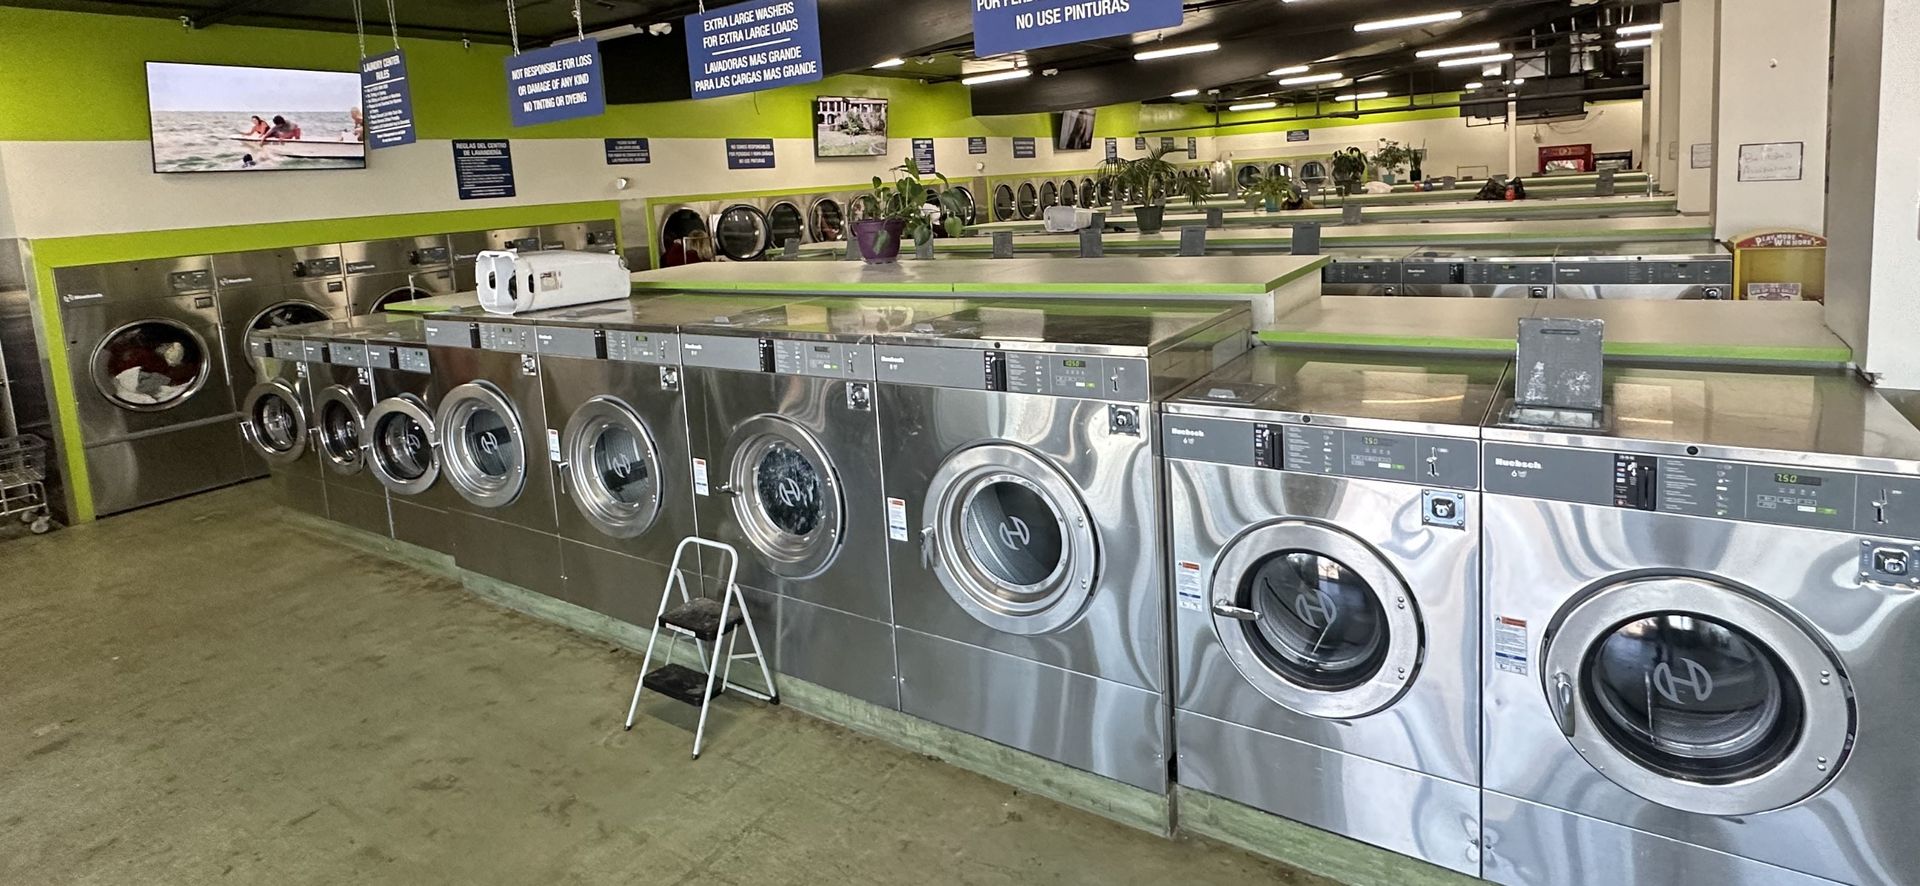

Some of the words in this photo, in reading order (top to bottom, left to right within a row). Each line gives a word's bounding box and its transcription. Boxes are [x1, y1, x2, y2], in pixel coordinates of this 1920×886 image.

[704, 16, 729, 32] EXTRA
[730, 11, 754, 27] LARGE
[755, 1, 794, 21] WASHERS
[1016, 13, 1033, 30] NO
[1036, 8, 1062, 26] USE
[1064, 0, 1130, 21] PINTURAS
[703, 36, 718, 49] FOR
[719, 31, 744, 46] EXTRA
[745, 25, 771, 40] LARGE
[772, 18, 798, 35] LOADS
[511, 68, 524, 80] NOT
[524, 61, 562, 78] RESPONSIBLE
[562, 57, 575, 70] FOR
[575, 54, 593, 67] LOSS
[704, 55, 748, 74] LAVADORAS
[749, 53, 768, 66] MAS
[768, 46, 802, 63] GRANDE
[518, 86, 526, 96] OR
[526, 80, 551, 95] DAMAGE
[551, 78, 560, 89] OF
[560, 75, 574, 88] ANY
[574, 73, 589, 86] KIND
[695, 78, 715, 92] PARA
[715, 76, 731, 89] LAS
[731, 70, 762, 87] CARGAS
[763, 67, 782, 81] MAS
[783, 61, 817, 78] GRANDE
[523, 102, 532, 112] NO
[533, 97, 555, 110] TINTING
[556, 95, 565, 107] OR
[565, 92, 587, 105] DYEING
[1495, 457, 1543, 469] Huebsch
[1511, 470, 1518, 478] 6
